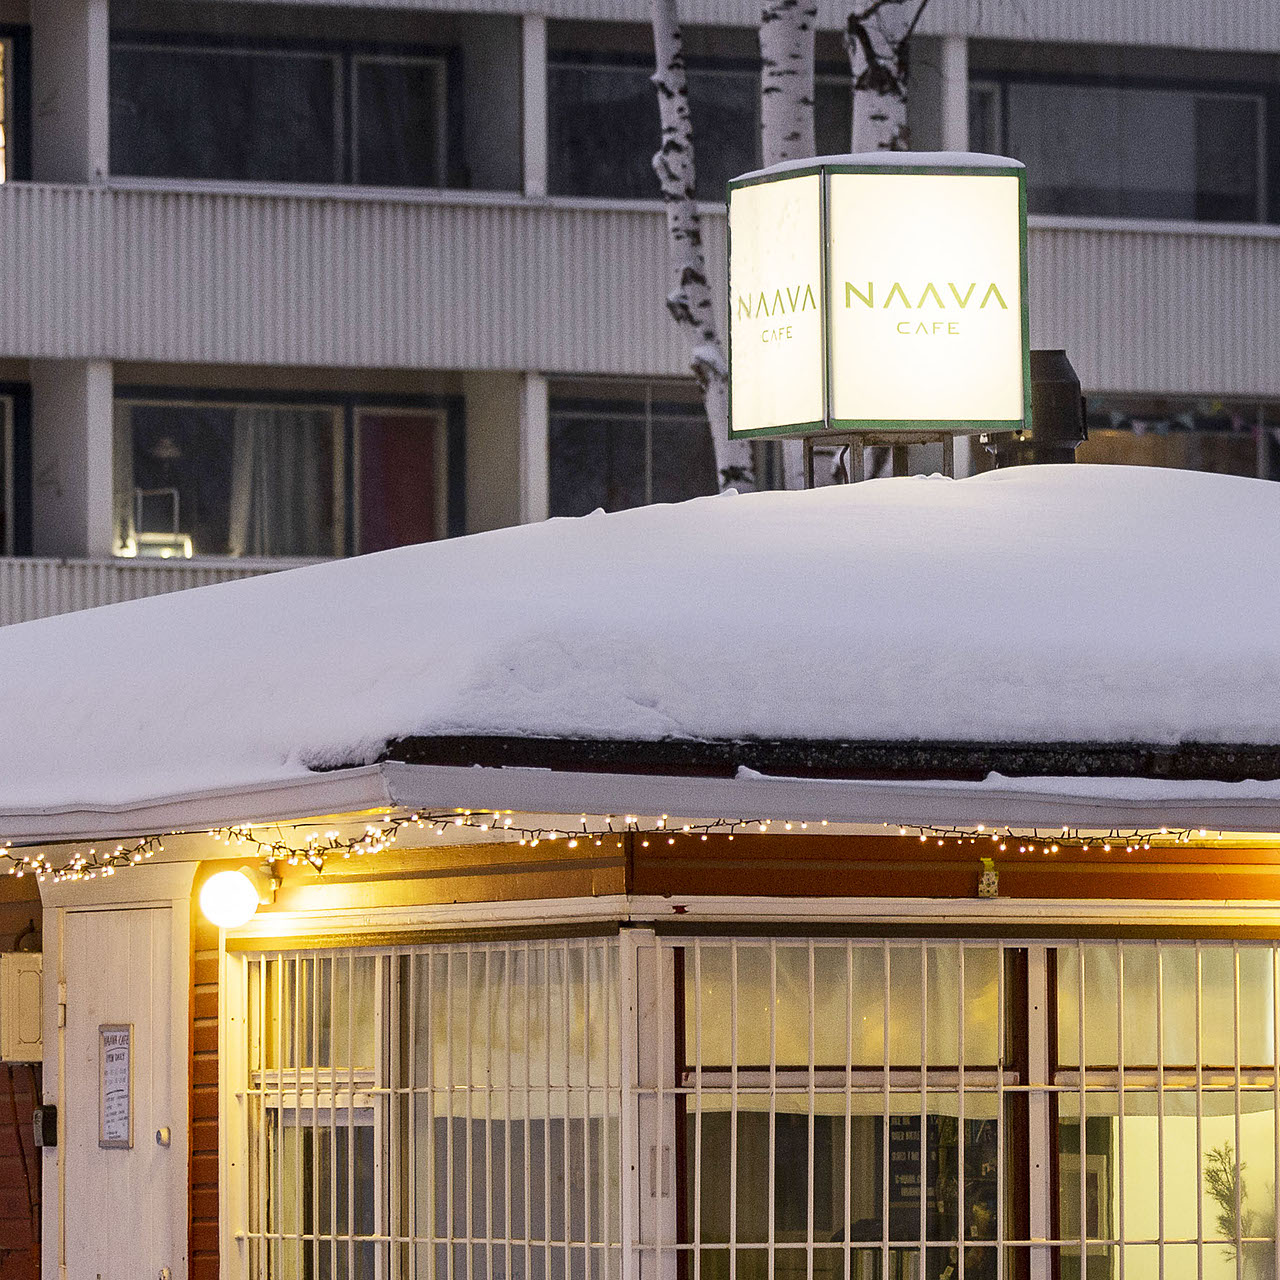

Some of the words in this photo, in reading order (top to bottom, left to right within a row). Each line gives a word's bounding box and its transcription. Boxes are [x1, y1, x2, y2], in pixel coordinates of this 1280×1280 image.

[738, 284, 816, 320] NAAVA
[845, 282, 1008, 309] NAAVA
[761, 326, 793, 343] CAFE
[896, 321, 960, 335] CAFE
